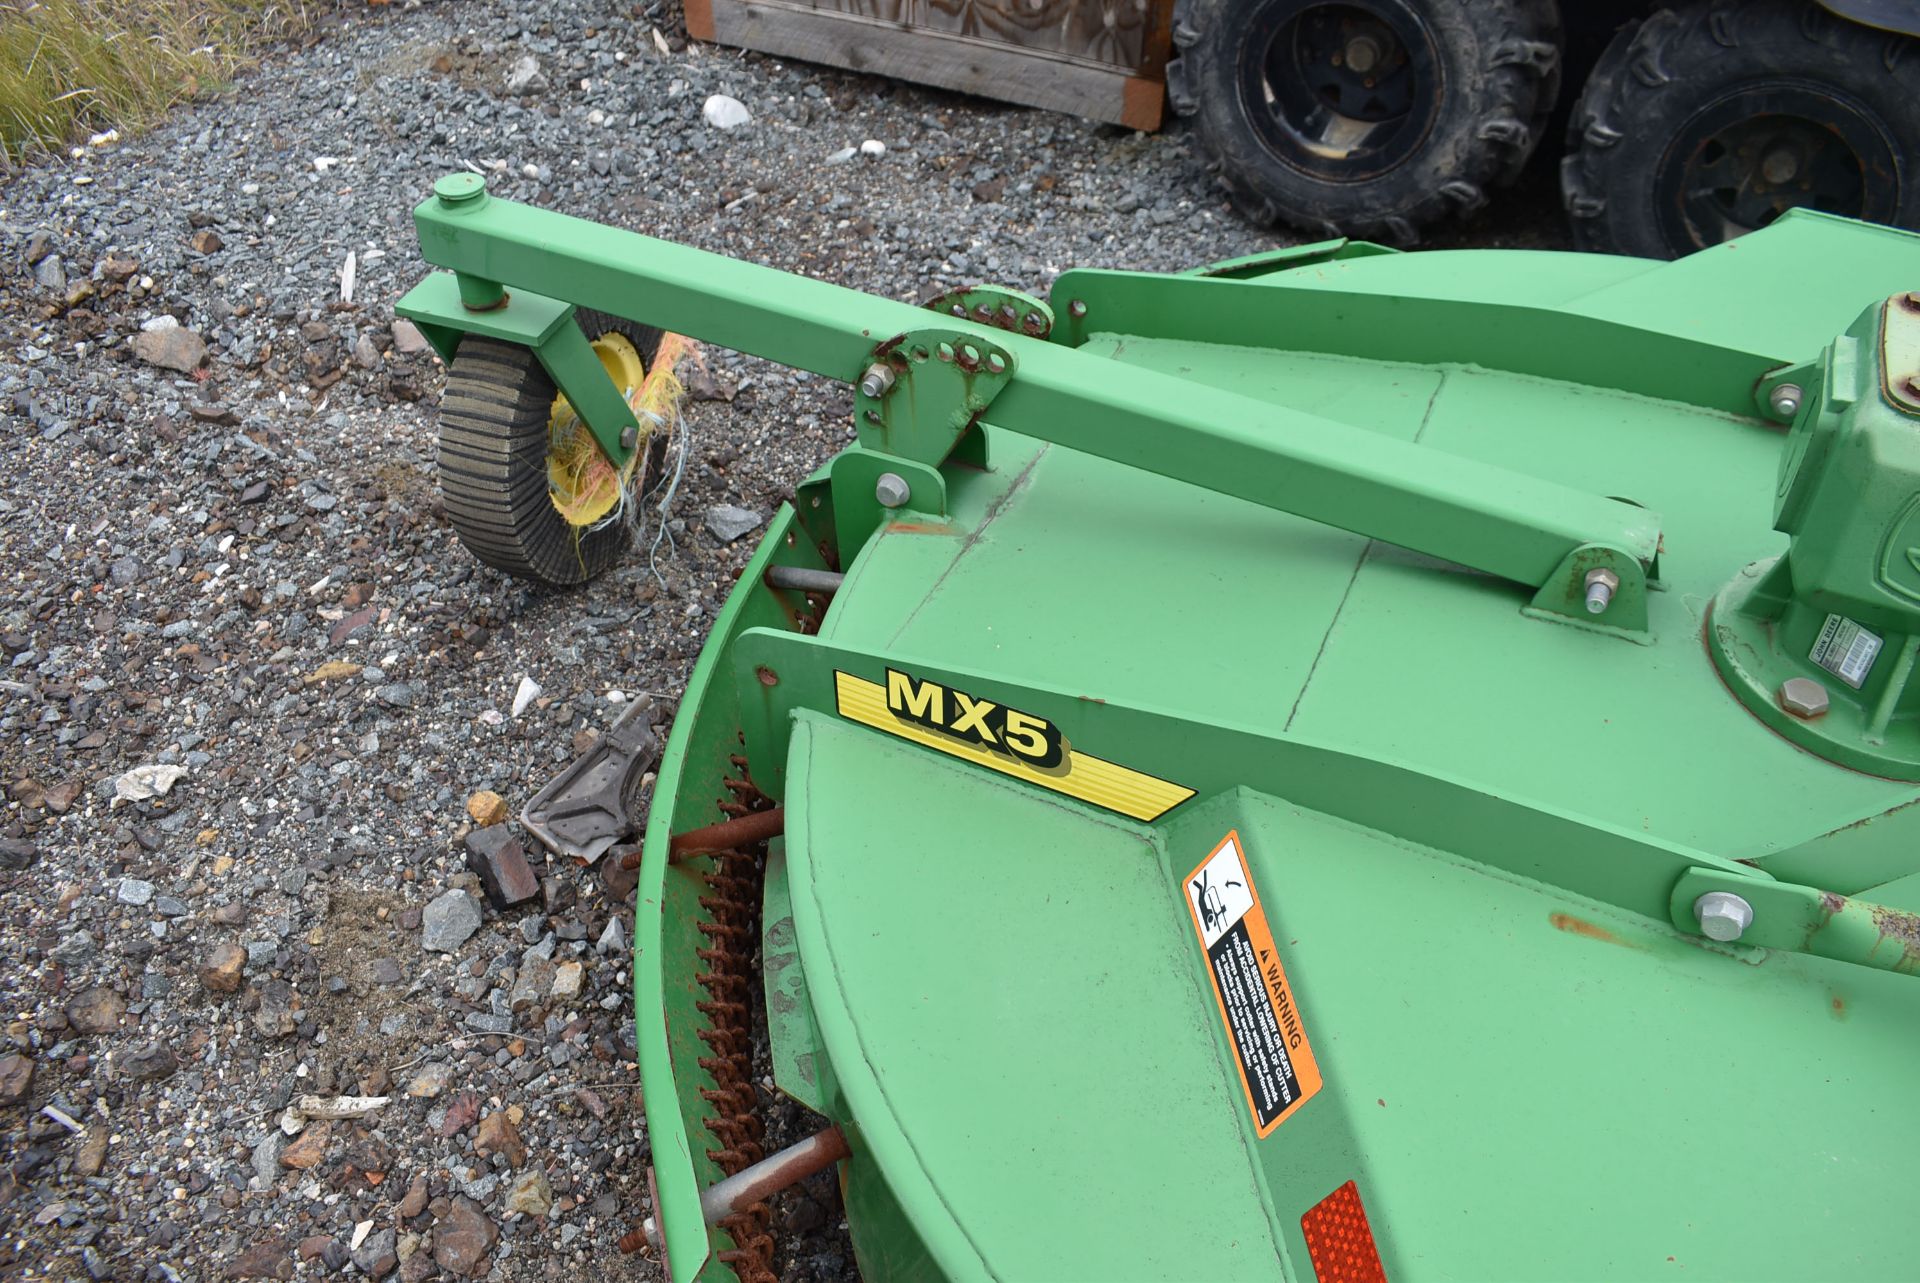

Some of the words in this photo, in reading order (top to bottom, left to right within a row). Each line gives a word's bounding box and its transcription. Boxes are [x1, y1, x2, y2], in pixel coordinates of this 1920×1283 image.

[1815, 639, 1828, 658] JOHN
[1824, 617, 1838, 639] DEERE
[886, 668, 1056, 764] MX5
[1221, 954, 1226, 962] or
[1224, 962, 1234, 988] blocks
[1215, 959, 1232, 1006] maintenance
[1230, 1006, 1240, 1028] under
[1242, 1044, 1252, 1070] cutter.
[1231, 988, 1240, 1006] prior
[1232, 932, 1243, 956] FROM
[1239, 956, 1259, 1008] ACCIDENTAL
[1256, 1006, 1274, 1053] LOWERING
[1271, 1053, 1279, 1066] OF
[1276, 1067, 1291, 1104] CUTTER
[1238, 1007, 1243, 1017] to
[1242, 941, 1254, 965] AVOID
[1251, 965, 1266, 1003] SERIOUS
[1263, 1002, 1277, 1032] INJURY
[1274, 1034, 1282, 1048] OR
[1278, 1048, 1292, 1079] DEATH
[1267, 963, 1301, 1050] WARNING
[1226, 949, 1237, 975] Always
[1235, 976, 1248, 1006] support
[1245, 1006, 1255, 1029] cutter
[1258, 1048, 1269, 1073] safety
[1266, 1074, 1278, 1102] stands
[1241, 1017, 1255, 1055] servicing
[1253, 1055, 1258, 1063] or
[1254, 1065, 1272, 1110] performing
